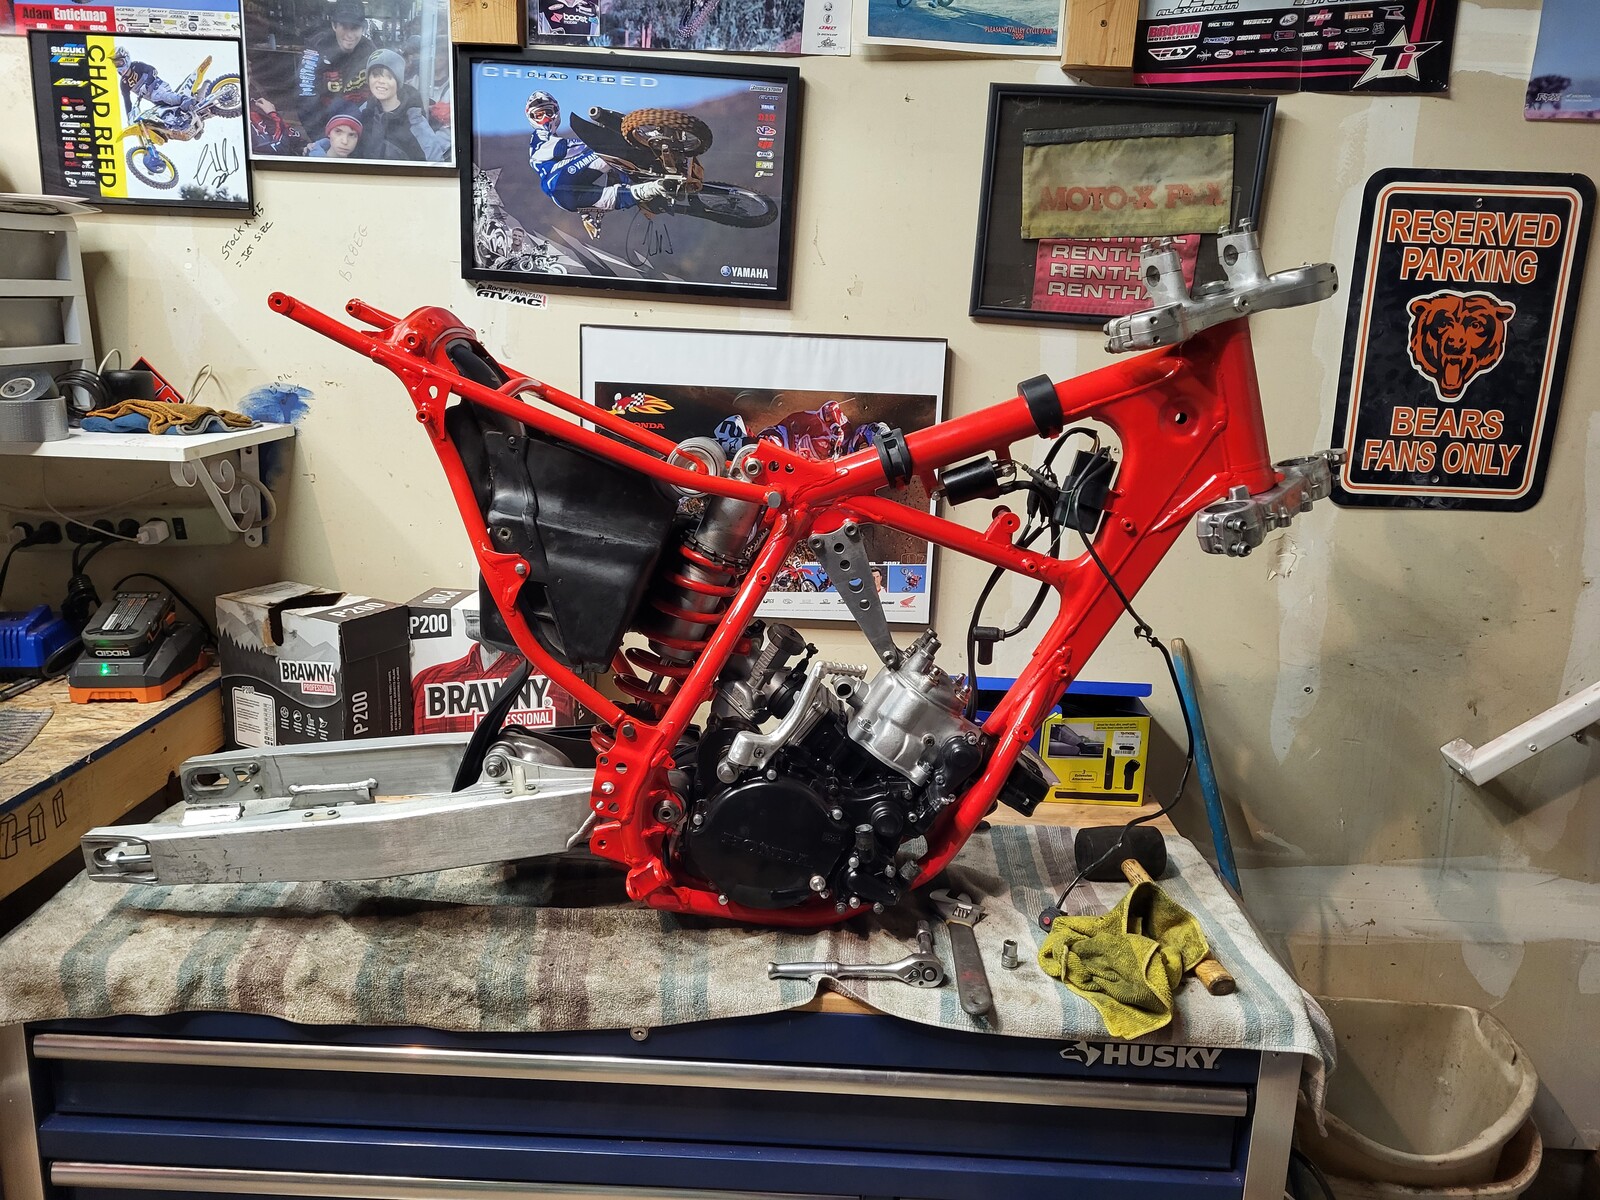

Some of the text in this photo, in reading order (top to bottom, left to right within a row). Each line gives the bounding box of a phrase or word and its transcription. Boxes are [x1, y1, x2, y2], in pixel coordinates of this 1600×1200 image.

[23, 7, 107, 22] Adam Enticknap
[563, 12, 588, 23] boost
[1156, 6, 1192, 16] ALEX
[1191, 2, 1240, 13] MARTIN
[984, 25, 1008, 33] PLEASANT
[1008, 26, 1025, 34] VALLEY
[1148, 22, 1201, 37] BROWN
[1148, 34, 1198, 42] MOTORSPORTS
[51, 46, 86, 54] SUZUKI
[88, 45, 110, 117] CHAD
[527, 71, 616, 83] CHAD REED
[94, 127, 117, 187] REED
[574, 152, 599, 170] YAMAH
[1039, 184, 1157, 212] MOTO-X
[1387, 208, 1562, 248] RESERVED
[221, 225, 246, 261] STOCK
[732, 266, 769, 279] YAMAHA
[1400, 246, 1538, 285] PARKING
[1389, 406, 1505, 440] BEARS
[1361, 438, 1522, 477] FANS ONLY
[327, 602, 386, 618] P200
[409, 613, 449, 635] P200
[281, 662, 332, 682] BRAWNY
[303, 683, 335, 693] PROFESSIONAL
[352, 690, 369, 736] P200
[1103, 1043, 1224, 1070] HUSKY
